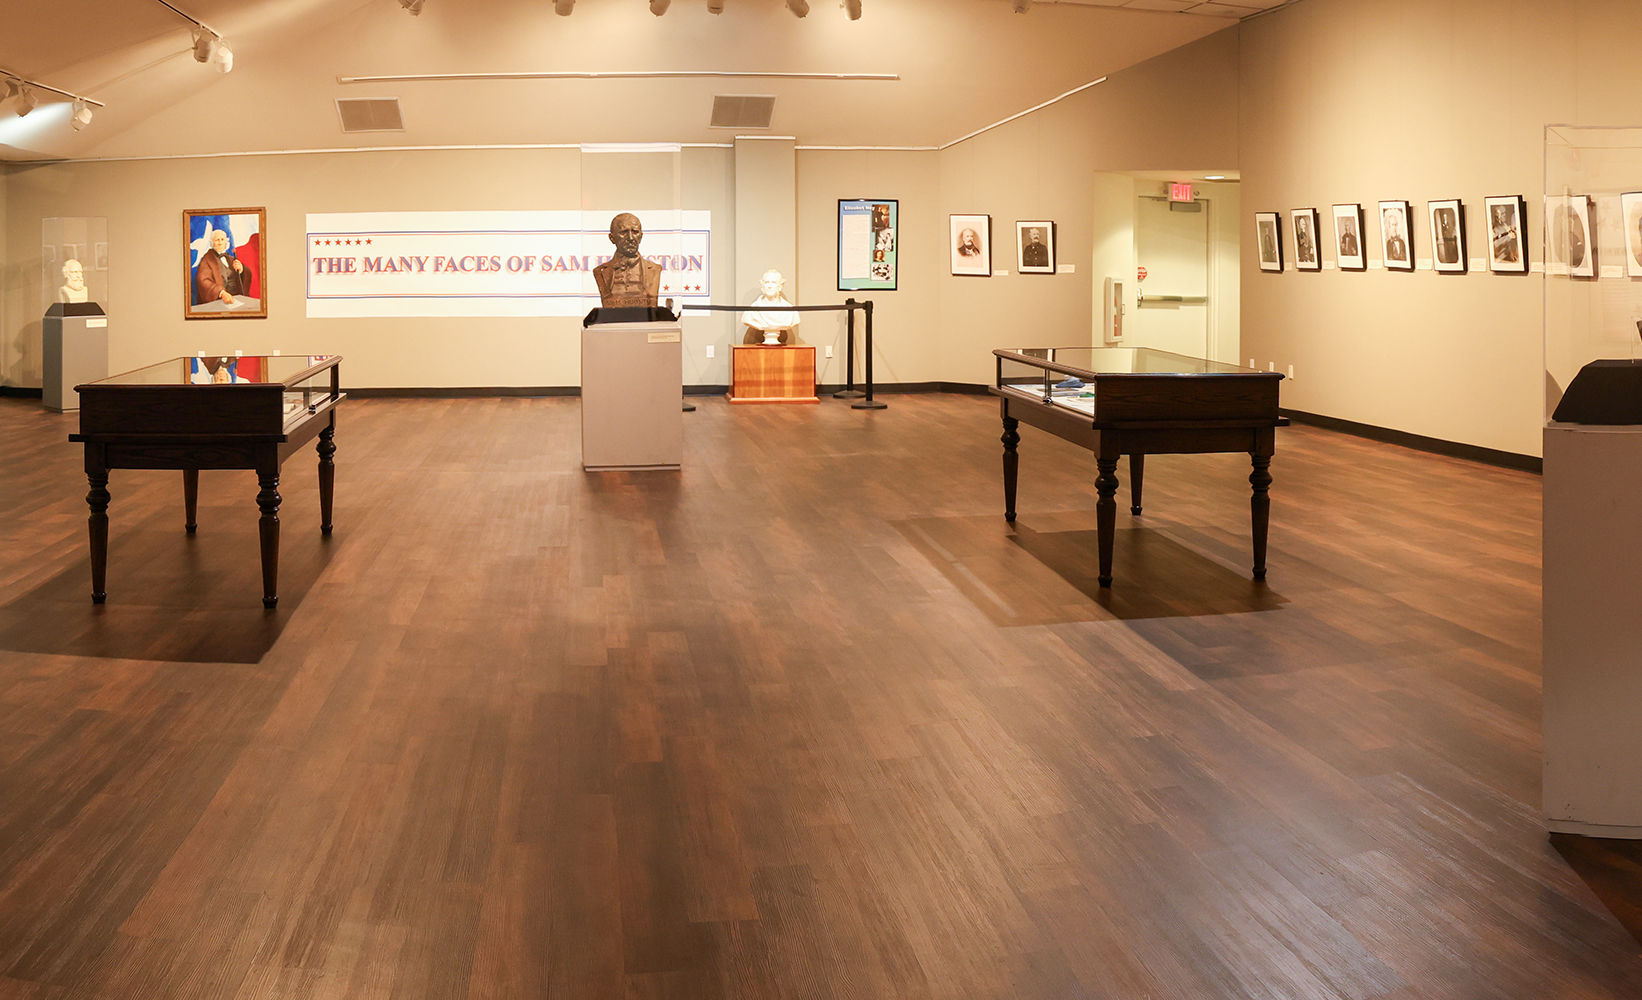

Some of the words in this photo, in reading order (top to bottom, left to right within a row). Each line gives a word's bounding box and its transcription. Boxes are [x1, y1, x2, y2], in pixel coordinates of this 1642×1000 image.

[1172, 184, 1192, 201] EXIT
[313, 256, 357, 274] THE
[363, 255, 429, 273] MANY
[433, 255, 501, 272] FACES
[507, 255, 536, 272] OF
[541, 255, 589, 272] SAM
